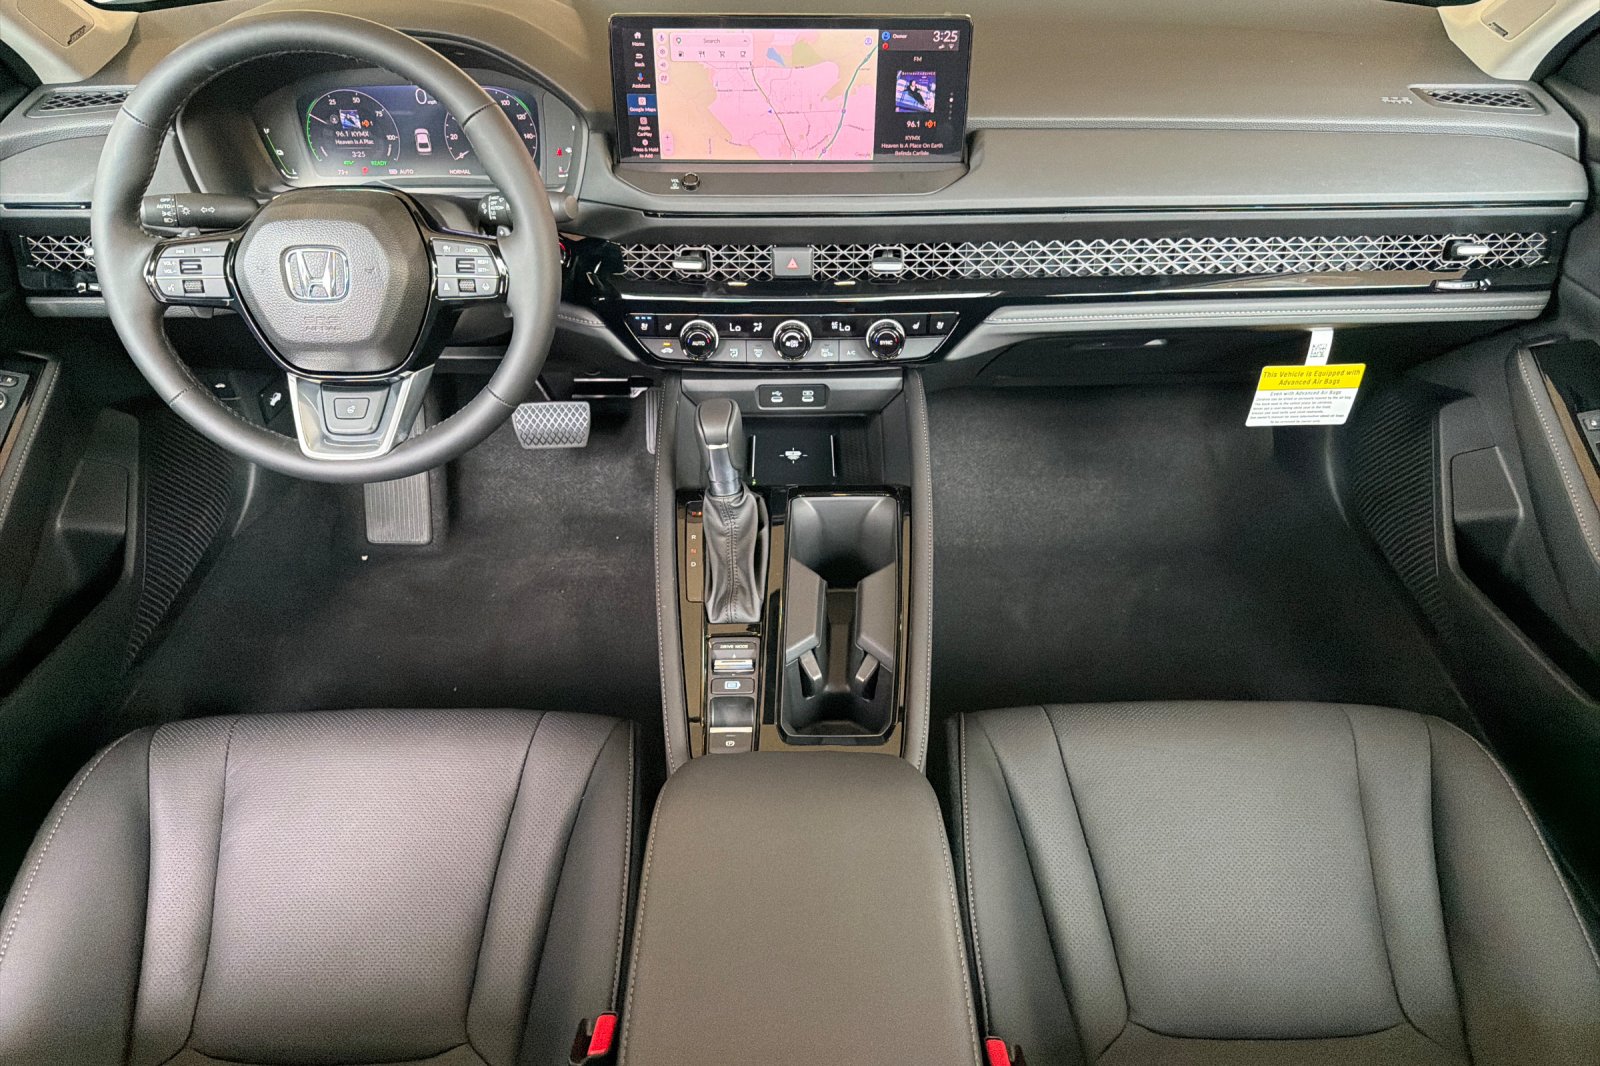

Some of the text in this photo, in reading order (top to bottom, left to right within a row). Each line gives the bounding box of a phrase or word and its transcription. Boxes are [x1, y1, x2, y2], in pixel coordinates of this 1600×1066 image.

[932, 30, 958, 42] 3:25
[415, 88, 427, 105] 0
[730, 323, 741, 332] Lo
[839, 323, 851, 331] Lo
[1314, 370, 1345, 378] Equipped
